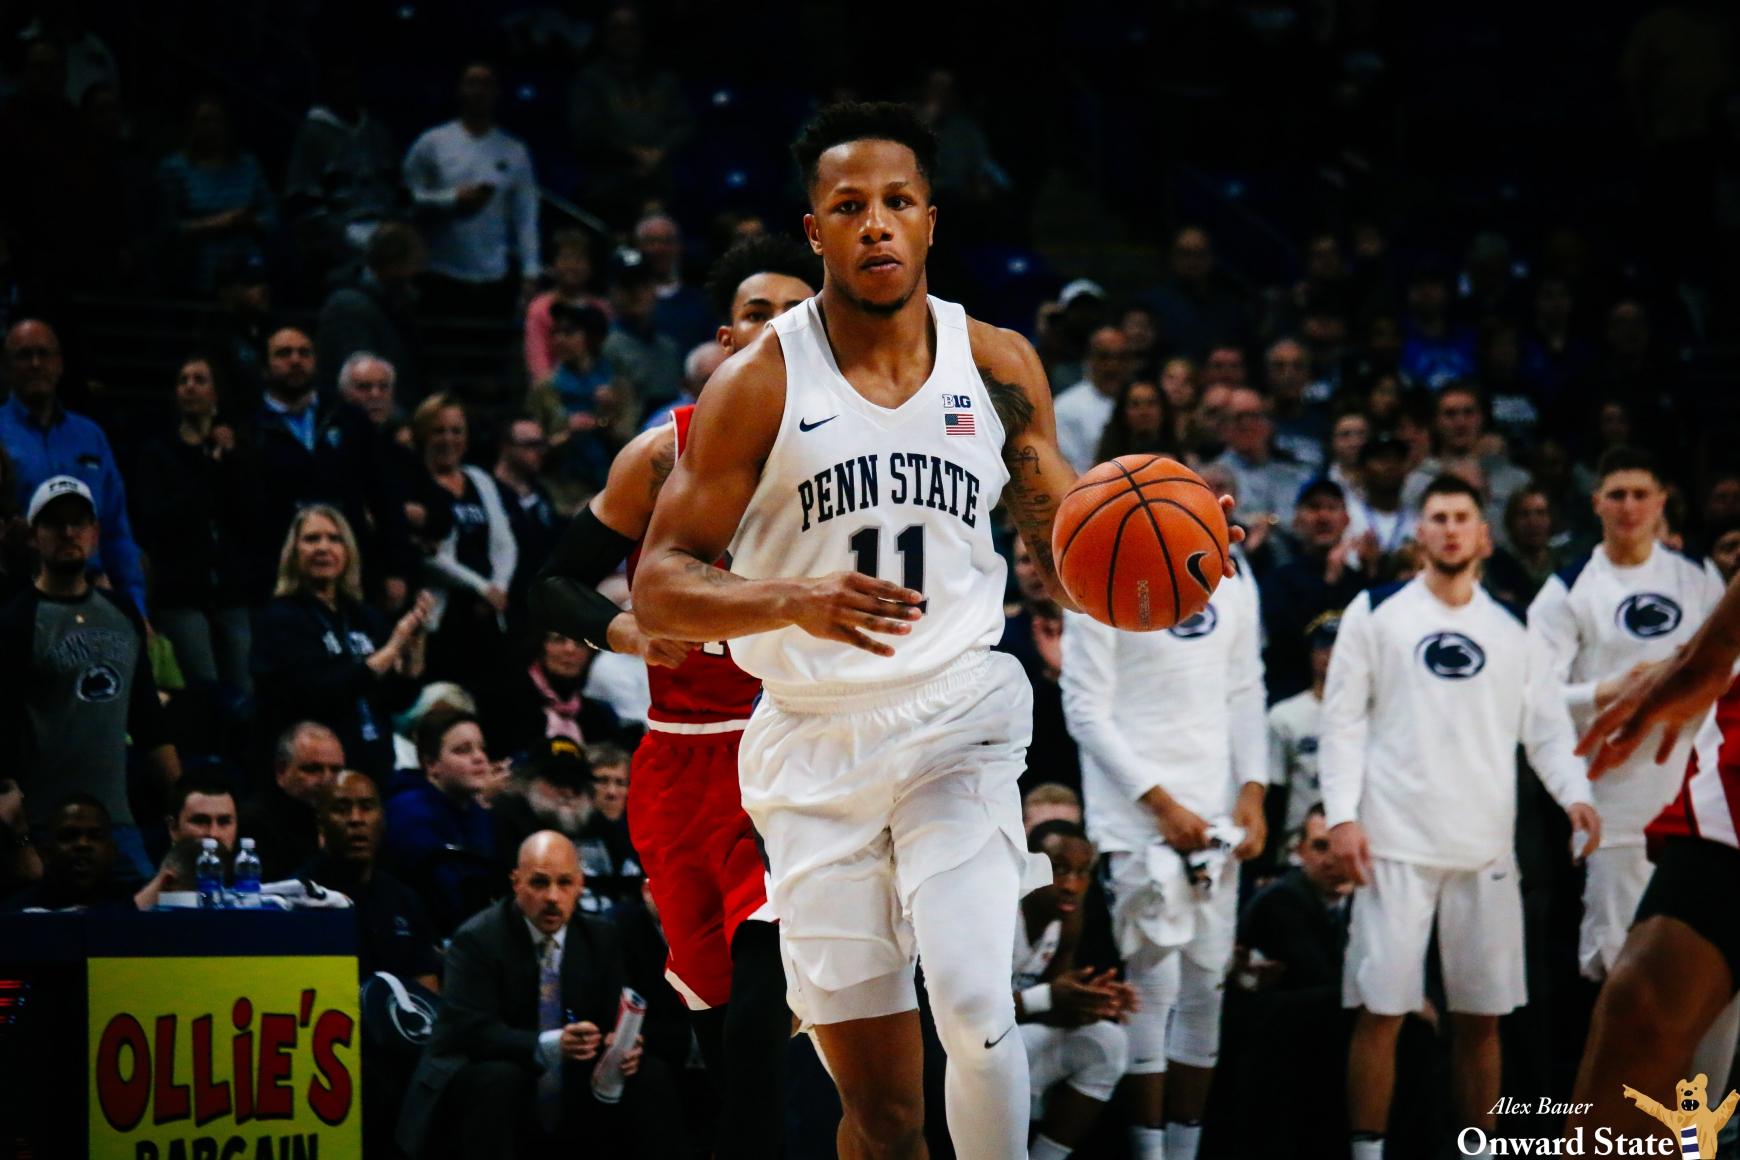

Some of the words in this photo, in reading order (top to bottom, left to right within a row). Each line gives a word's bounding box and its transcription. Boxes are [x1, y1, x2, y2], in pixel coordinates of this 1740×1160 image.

[942, 394, 971, 408] BIG
[798, 454, 878, 532] PENN
[890, 452, 980, 529] STATE
[848, 523, 929, 615] 11
